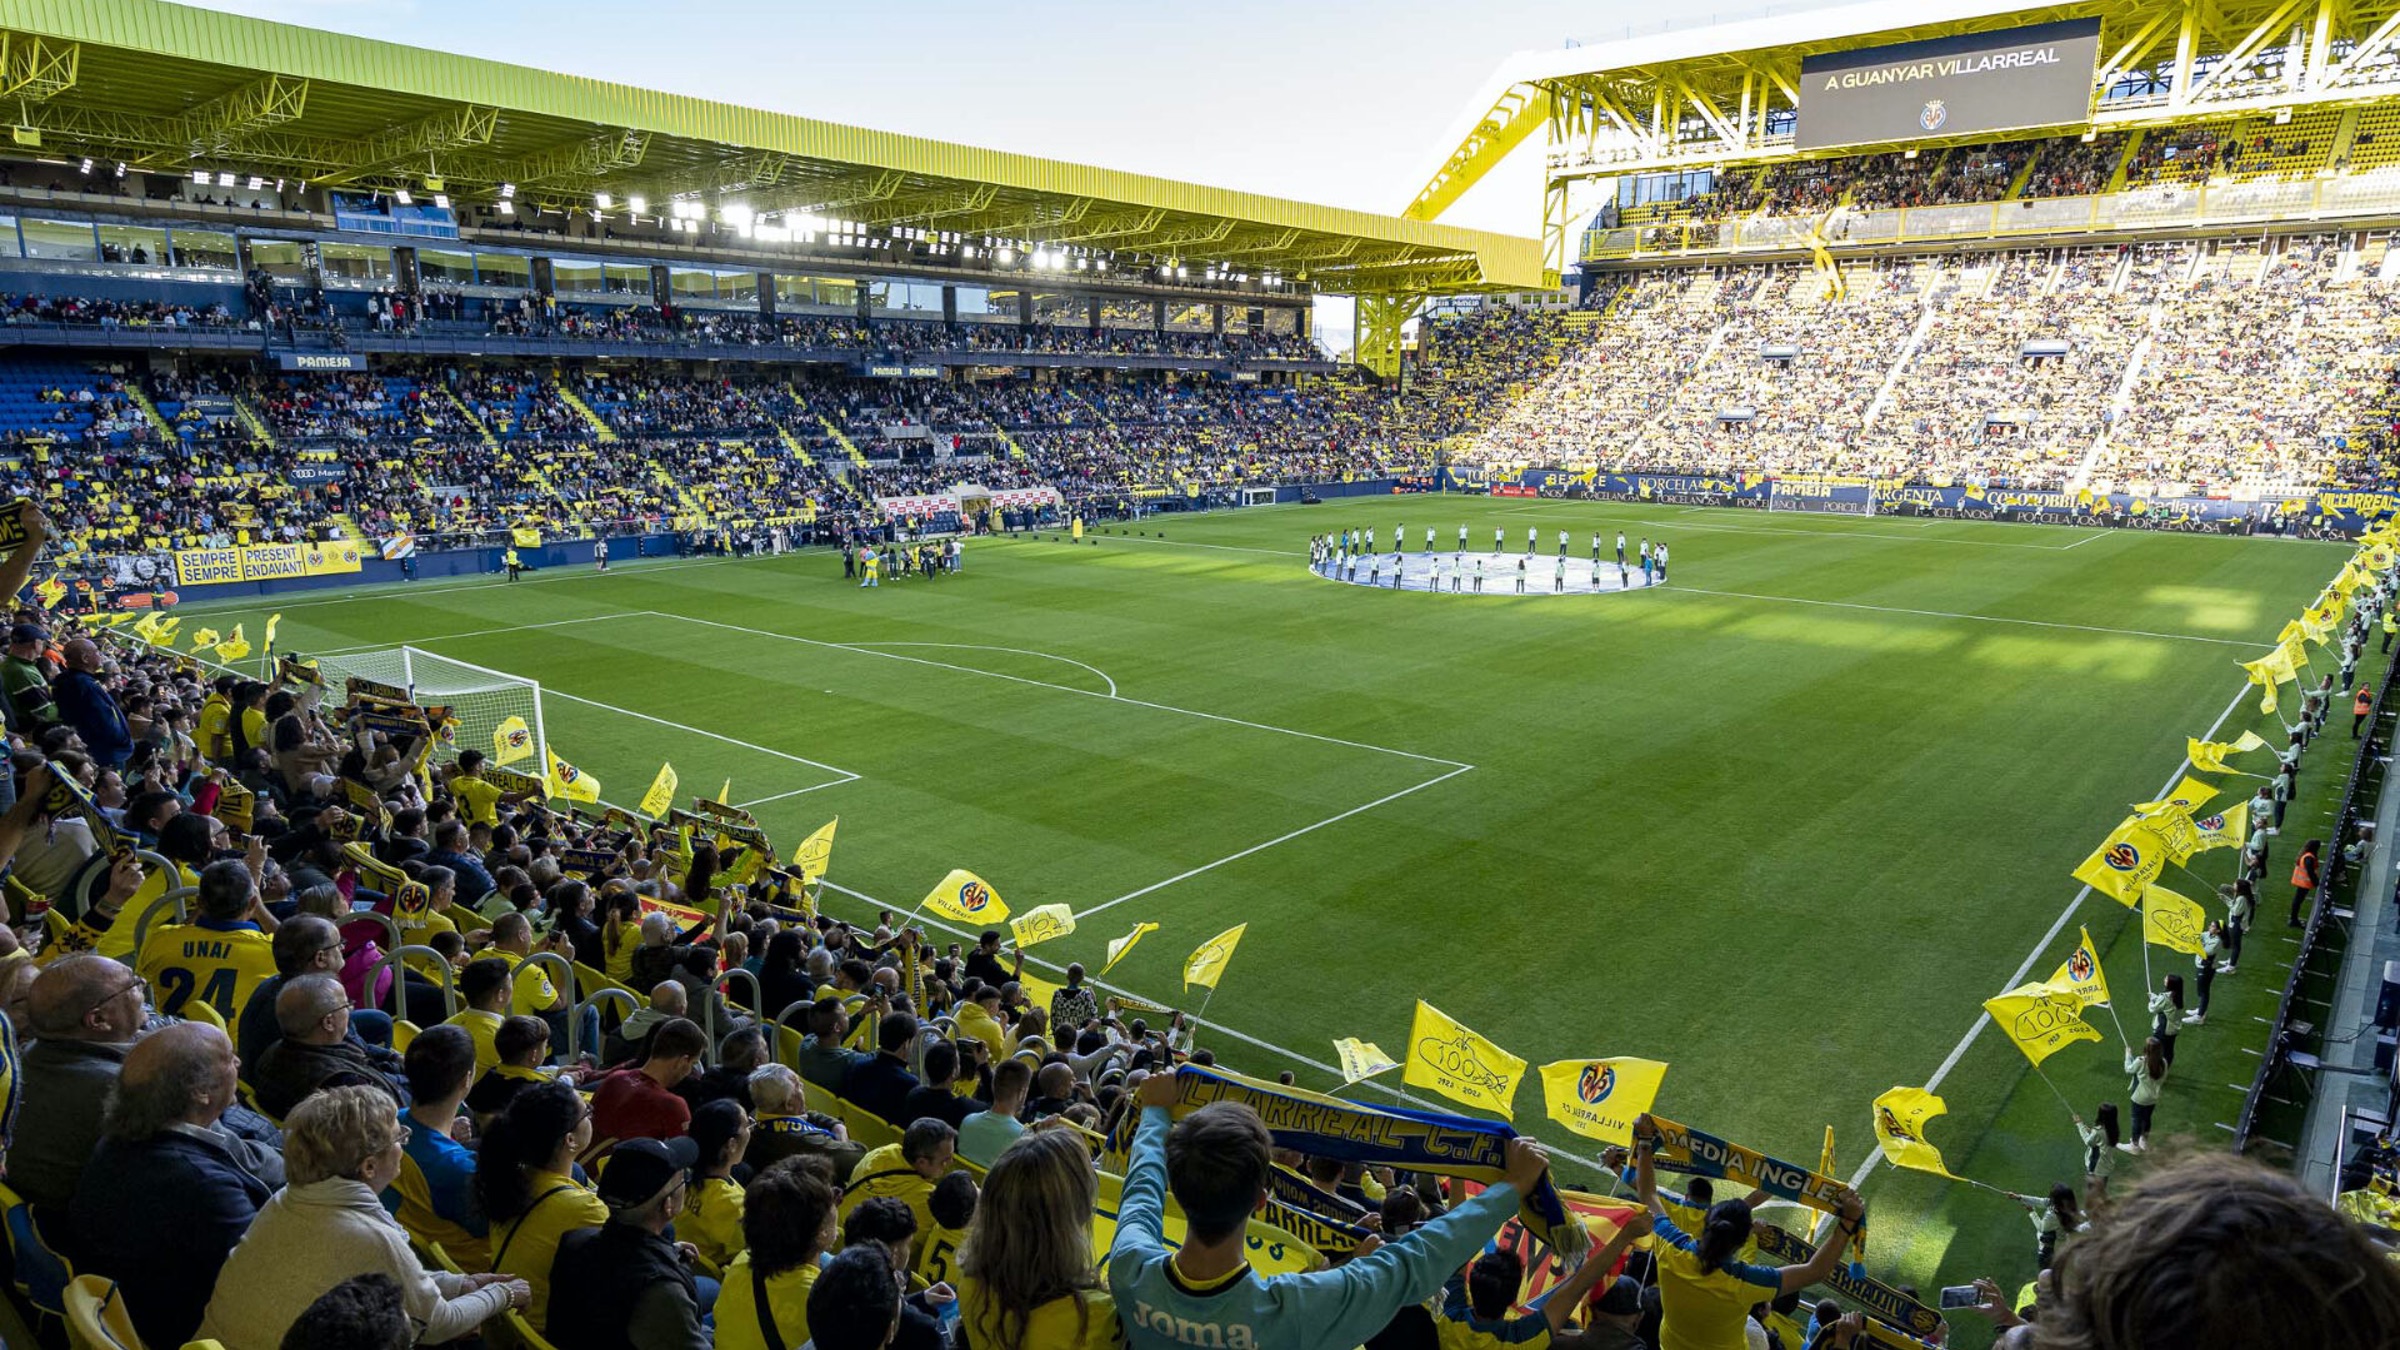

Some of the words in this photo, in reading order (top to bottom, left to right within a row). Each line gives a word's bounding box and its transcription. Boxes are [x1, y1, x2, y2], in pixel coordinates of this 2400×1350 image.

[1824, 76, 1839, 91] A
[1842, 63, 1934, 88] GUANYAR
[1937, 48, 2060, 78] VILLARREAL
[297, 356, 351, 368] PAMESA
[1773, 483, 1831, 498] PAMESA
[1872, 489, 1944, 503] ARGENTA
[182, 551, 236, 567] SEMPRE
[246, 547, 297, 562] PRESENT
[185, 565, 239, 582] SEMPRE
[245, 560, 303, 577] ENDAVANT
[183, 941, 232, 959] UNAI
[158, 967, 239, 1020] 24
[1667, 1129, 1747, 1176] MEDIA
[927, 1240, 955, 1284] 5
[1132, 1300, 1259, 1350] Joma
